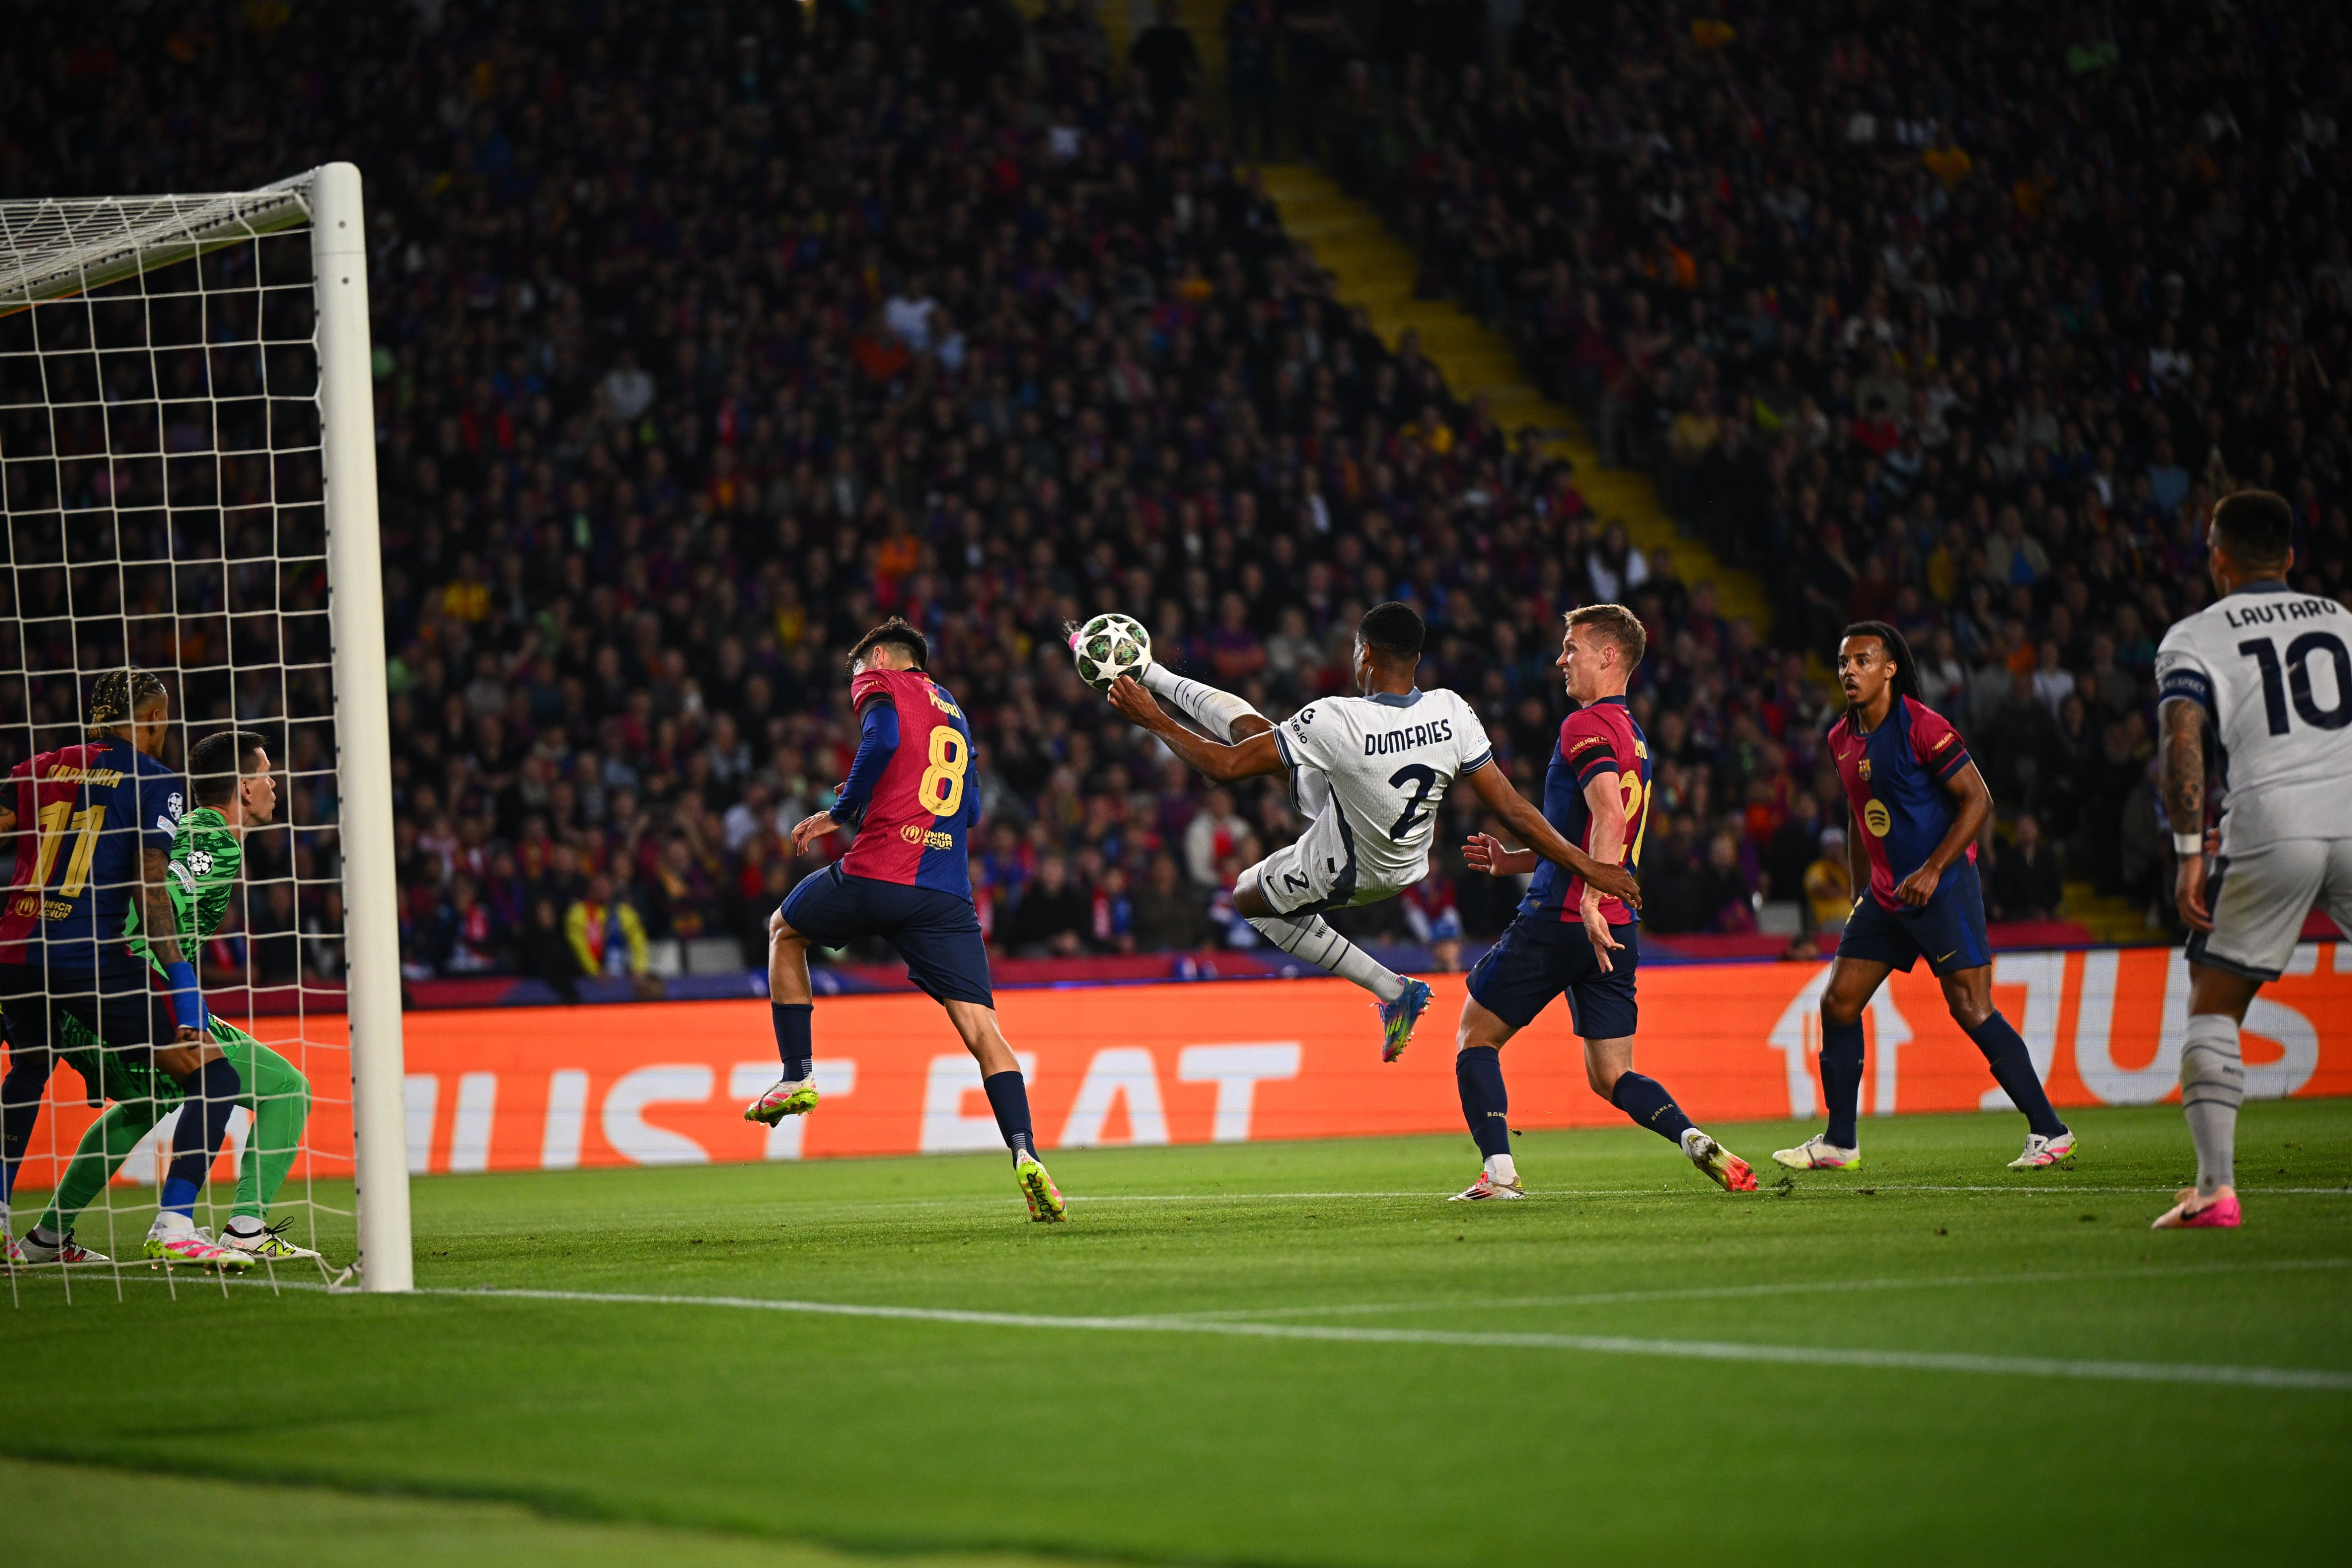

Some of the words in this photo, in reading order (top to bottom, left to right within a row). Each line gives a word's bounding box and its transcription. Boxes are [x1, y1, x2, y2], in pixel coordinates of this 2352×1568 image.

[2225, 599, 2337, 629] LAUTARO
[2238, 631, 2352, 736] 10
[928, 690, 961, 720] PEDRI
[1364, 718, 1452, 756] DUMFRIES
[1570, 736, 1600, 754] AMBILIGHT
[918, 725, 968, 817] 8
[1388, 763, 1436, 842] 2
[24, 800, 107, 899] 11
[1283, 870, 1310, 893] 2
